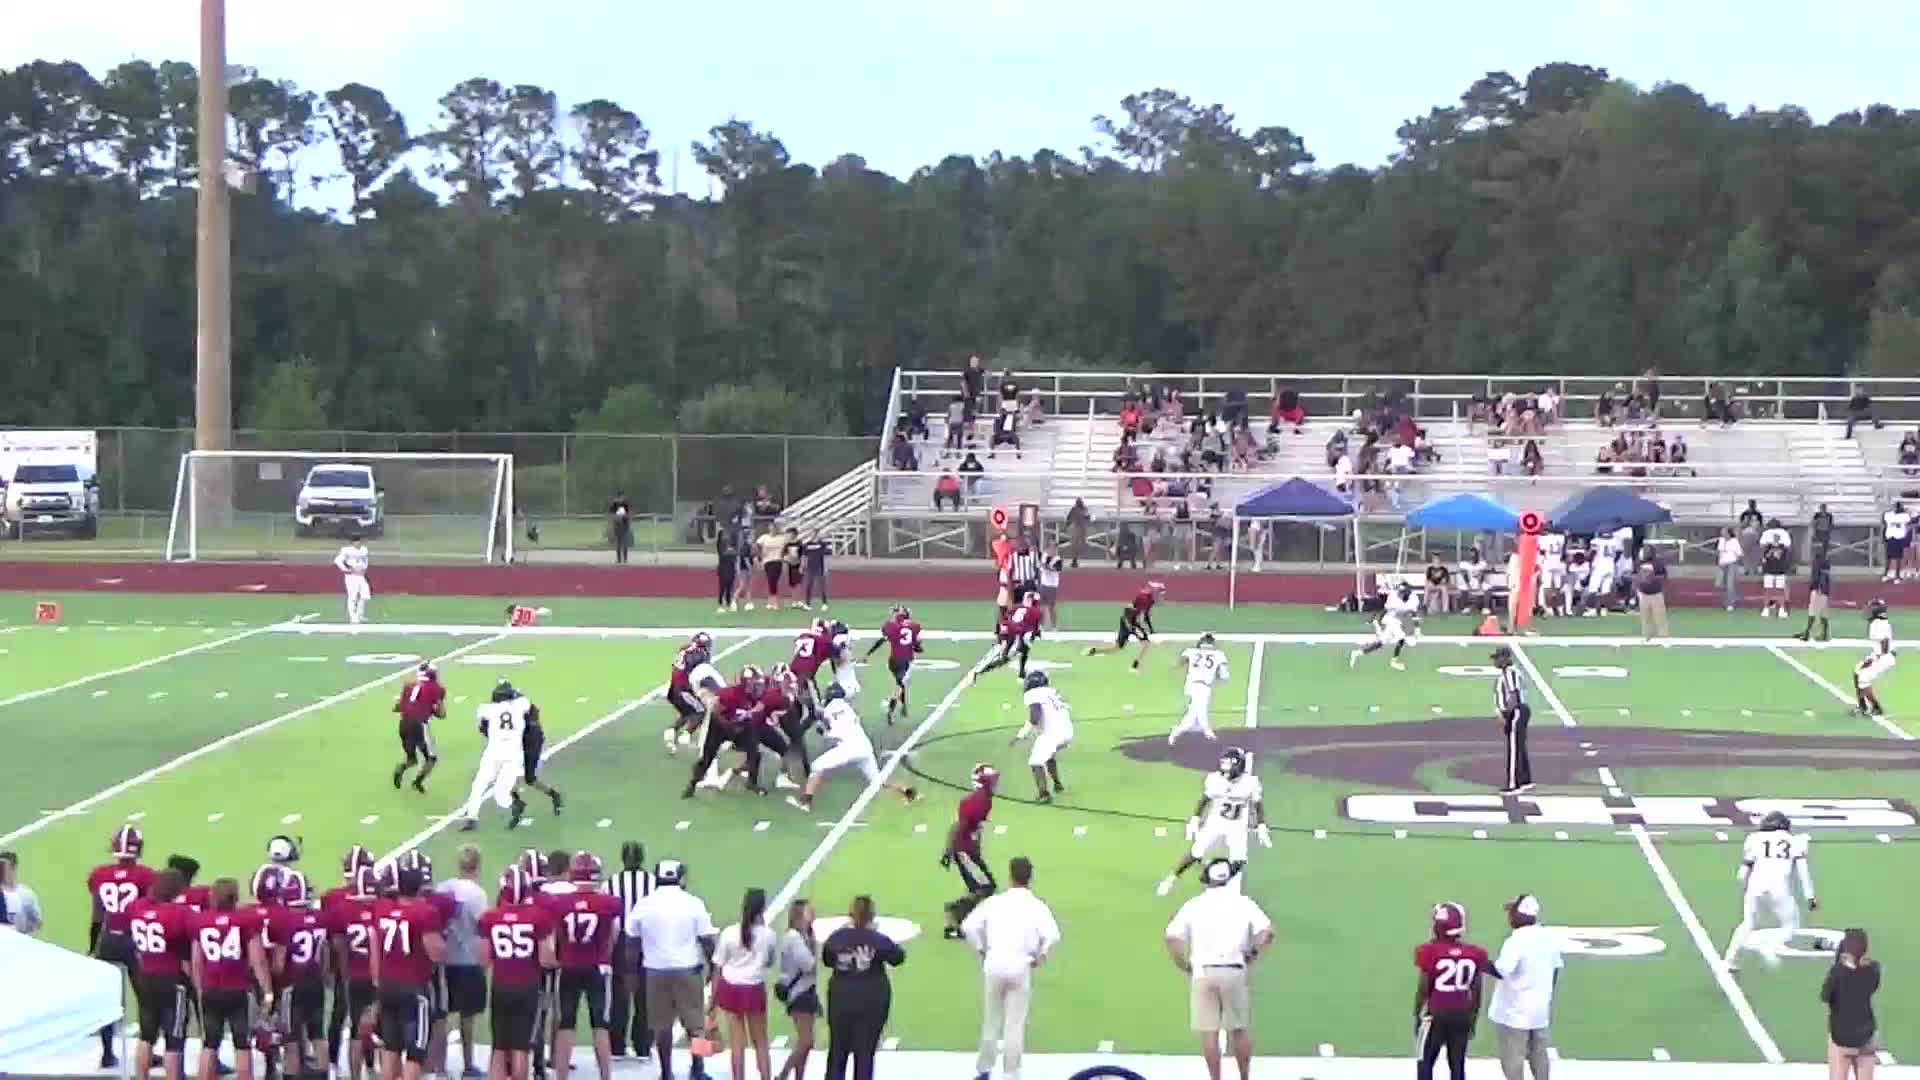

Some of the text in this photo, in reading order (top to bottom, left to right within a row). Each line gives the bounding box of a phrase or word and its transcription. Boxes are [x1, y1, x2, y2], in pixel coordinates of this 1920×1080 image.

[899, 627, 913, 645] 3
[1193, 653, 1215, 669] 25
[500, 711, 513, 730] 8
[1762, 839, 1791, 859] 13
[131, 919, 166, 953] 66
[200, 926, 240, 961] 64
[379, 917, 411, 954] 71
[491, 923, 535, 958] 65
[563, 912, 599, 943] 17
[1434, 958, 1476, 992] 20
